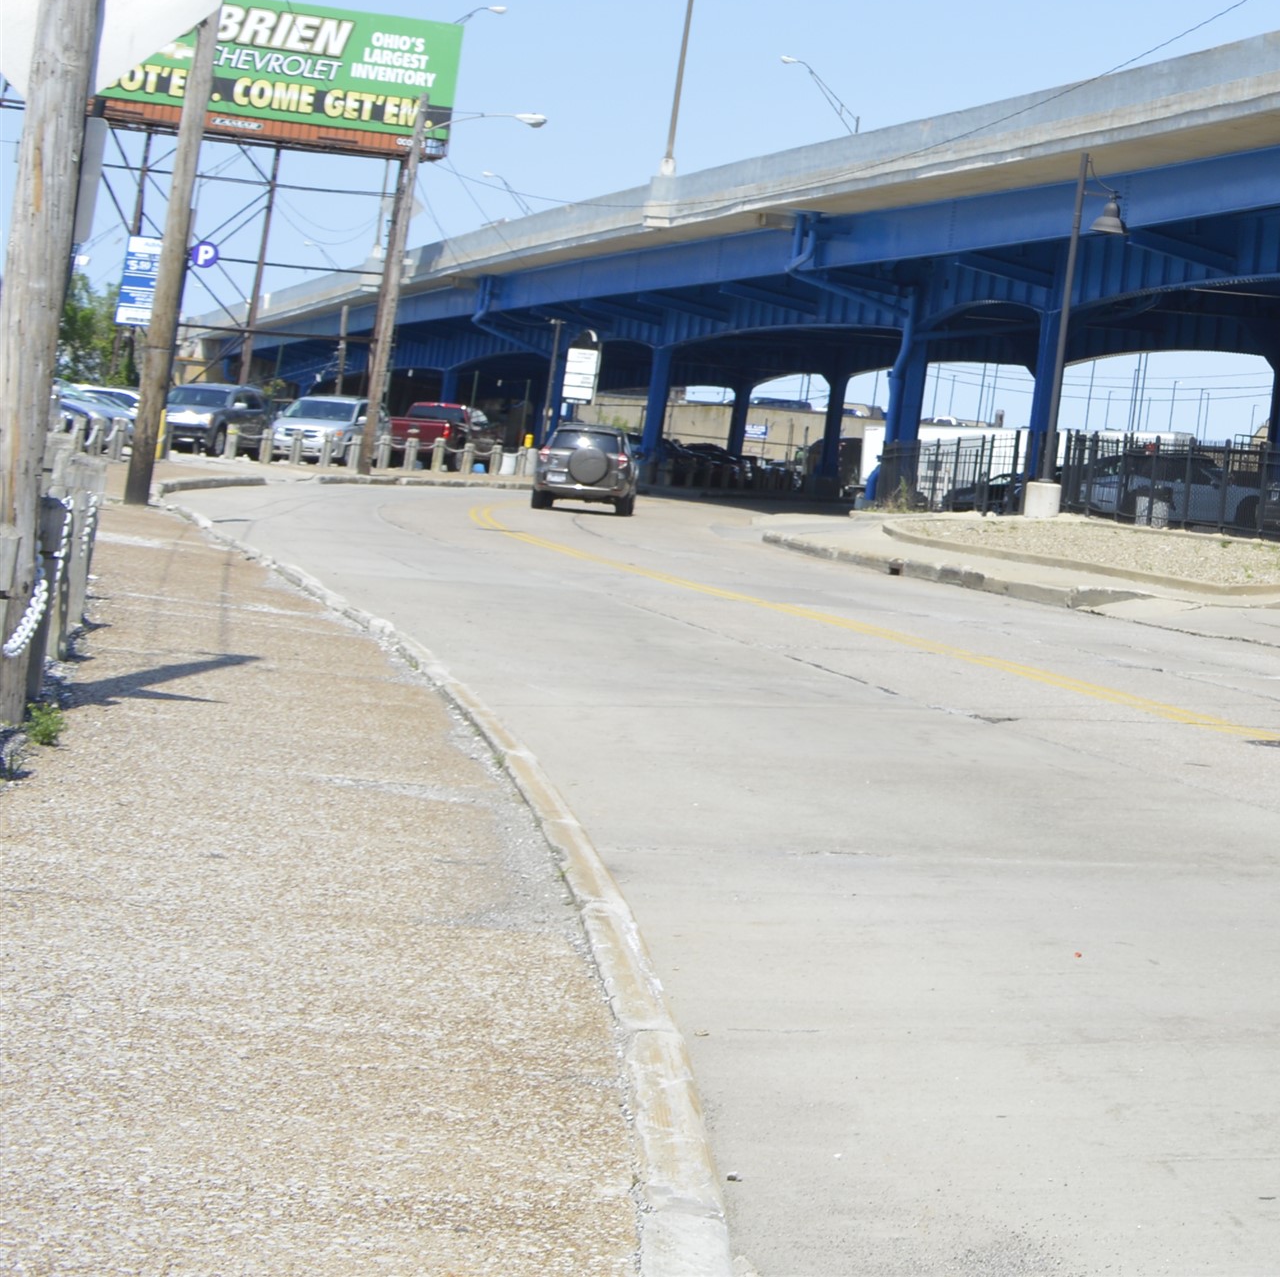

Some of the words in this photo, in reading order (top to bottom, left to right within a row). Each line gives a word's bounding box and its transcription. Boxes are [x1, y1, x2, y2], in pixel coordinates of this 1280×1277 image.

[371, 32, 425, 53] OHIO'S
[363, 47, 429, 70] LARGEST
[351, 62, 436, 88] INVENTORY
[105, 64, 221, 102] OT'E.
[233, 77, 316, 114] COME
[197, 245, 215, 265] P
